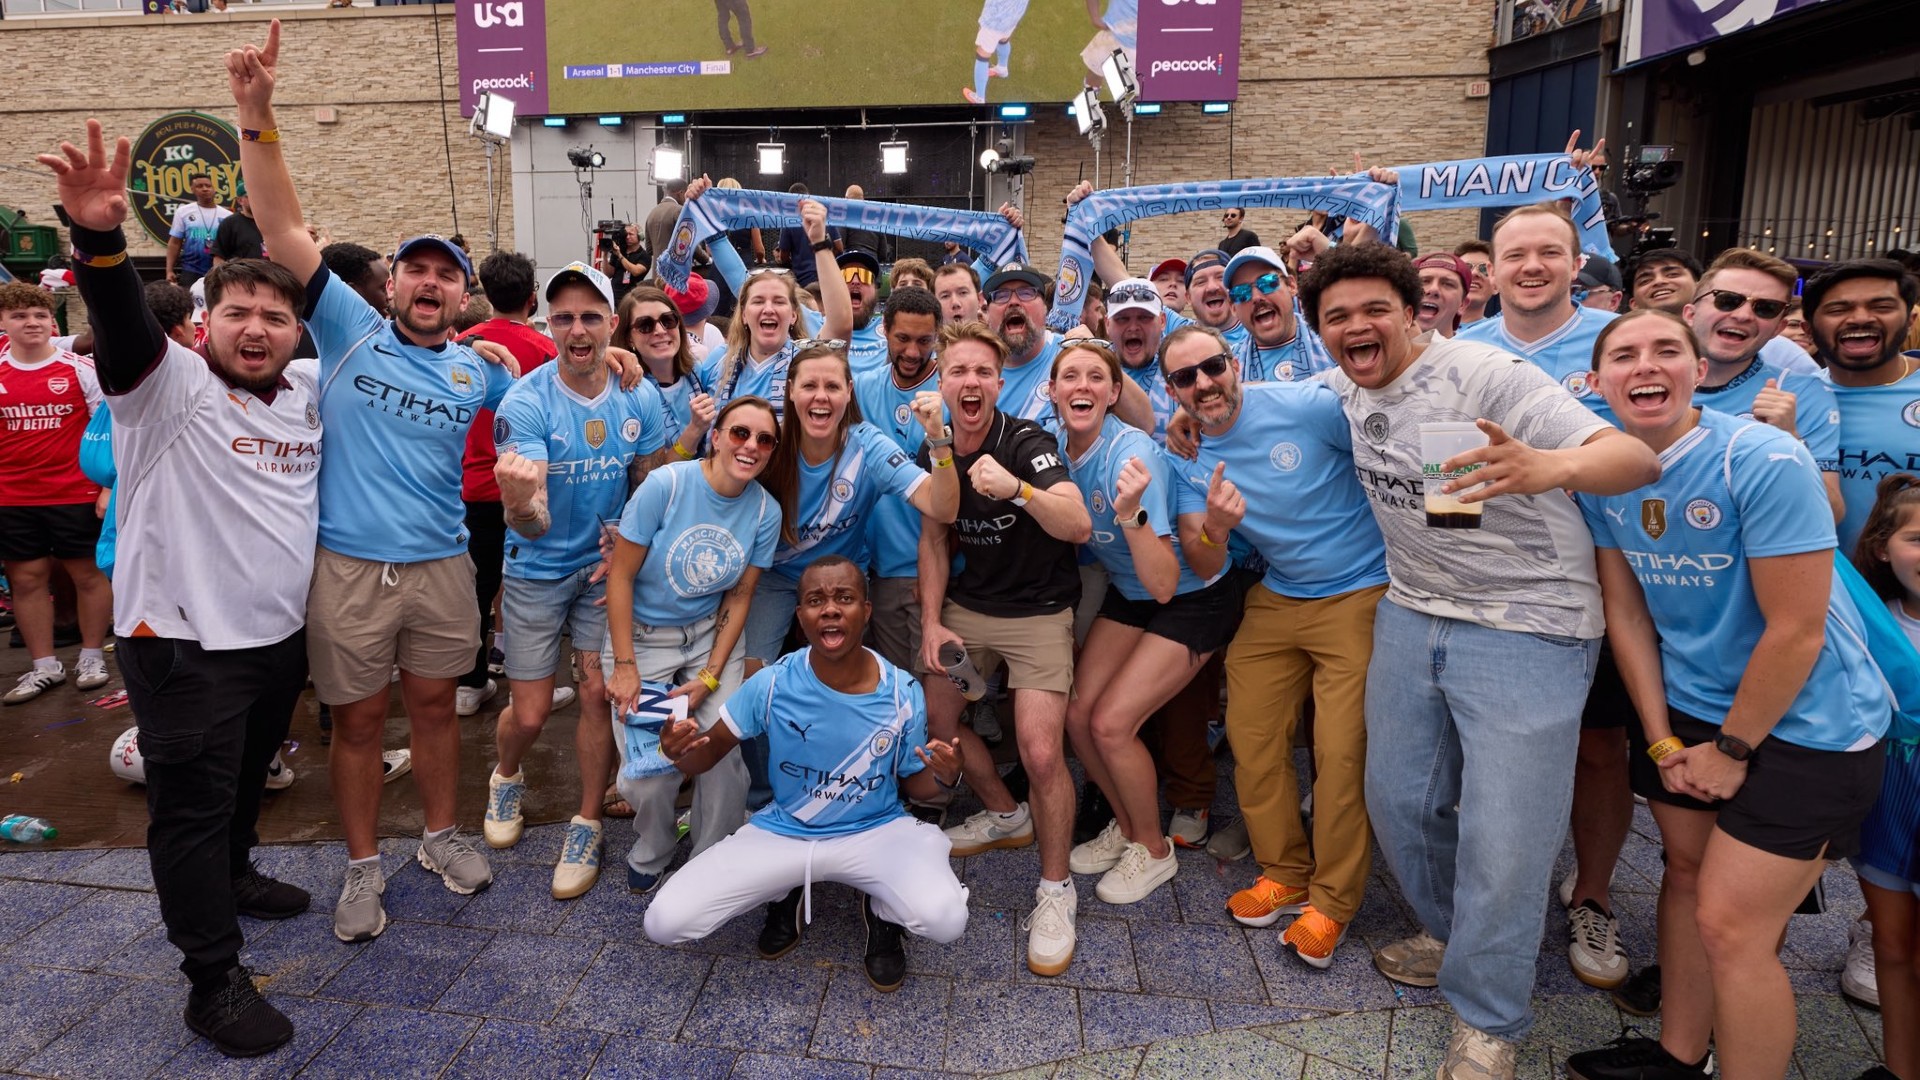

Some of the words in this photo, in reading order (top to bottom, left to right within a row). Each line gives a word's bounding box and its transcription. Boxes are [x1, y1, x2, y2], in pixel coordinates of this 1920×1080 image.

[572, 67, 604, 77] Arsenal
[609, 67, 621, 75] 1-1
[626, 65, 676, 75] Manchester
[677, 64, 696, 74] City
[706, 62, 727, 72] Final
[1151, 55, 1217, 78] peacock
[473, 74, 529, 95] peacock
[1471, 83, 1487, 95] EXIT
[163, 144, 194, 162] KC
[1420, 160, 1537, 199] MAN
[711, 196, 849, 221] KANSS
[860, 204, 1008, 246] CITYZENS
[353, 374, 472, 424] ETIHAD
[0, 402, 74, 418] mirates
[366, 399, 458, 433] AIRWAYS
[7, 419, 22, 431] FLY
[23, 417, 62, 431] BETTER
[256, 461, 316, 474] AIRWAYS
[547, 451, 636, 475] ETIHAD
[565, 470, 624, 485] AIRWAYS
[952, 513, 1017, 533] TIHAD
[681, 529, 738, 560] MANCHESTER
[1639, 572, 1715, 587] AIRWAYS
[686, 586, 710, 594] CITY
[779, 760, 886, 792] ETIHAD
[801, 784, 864, 804] AIRWAYS
